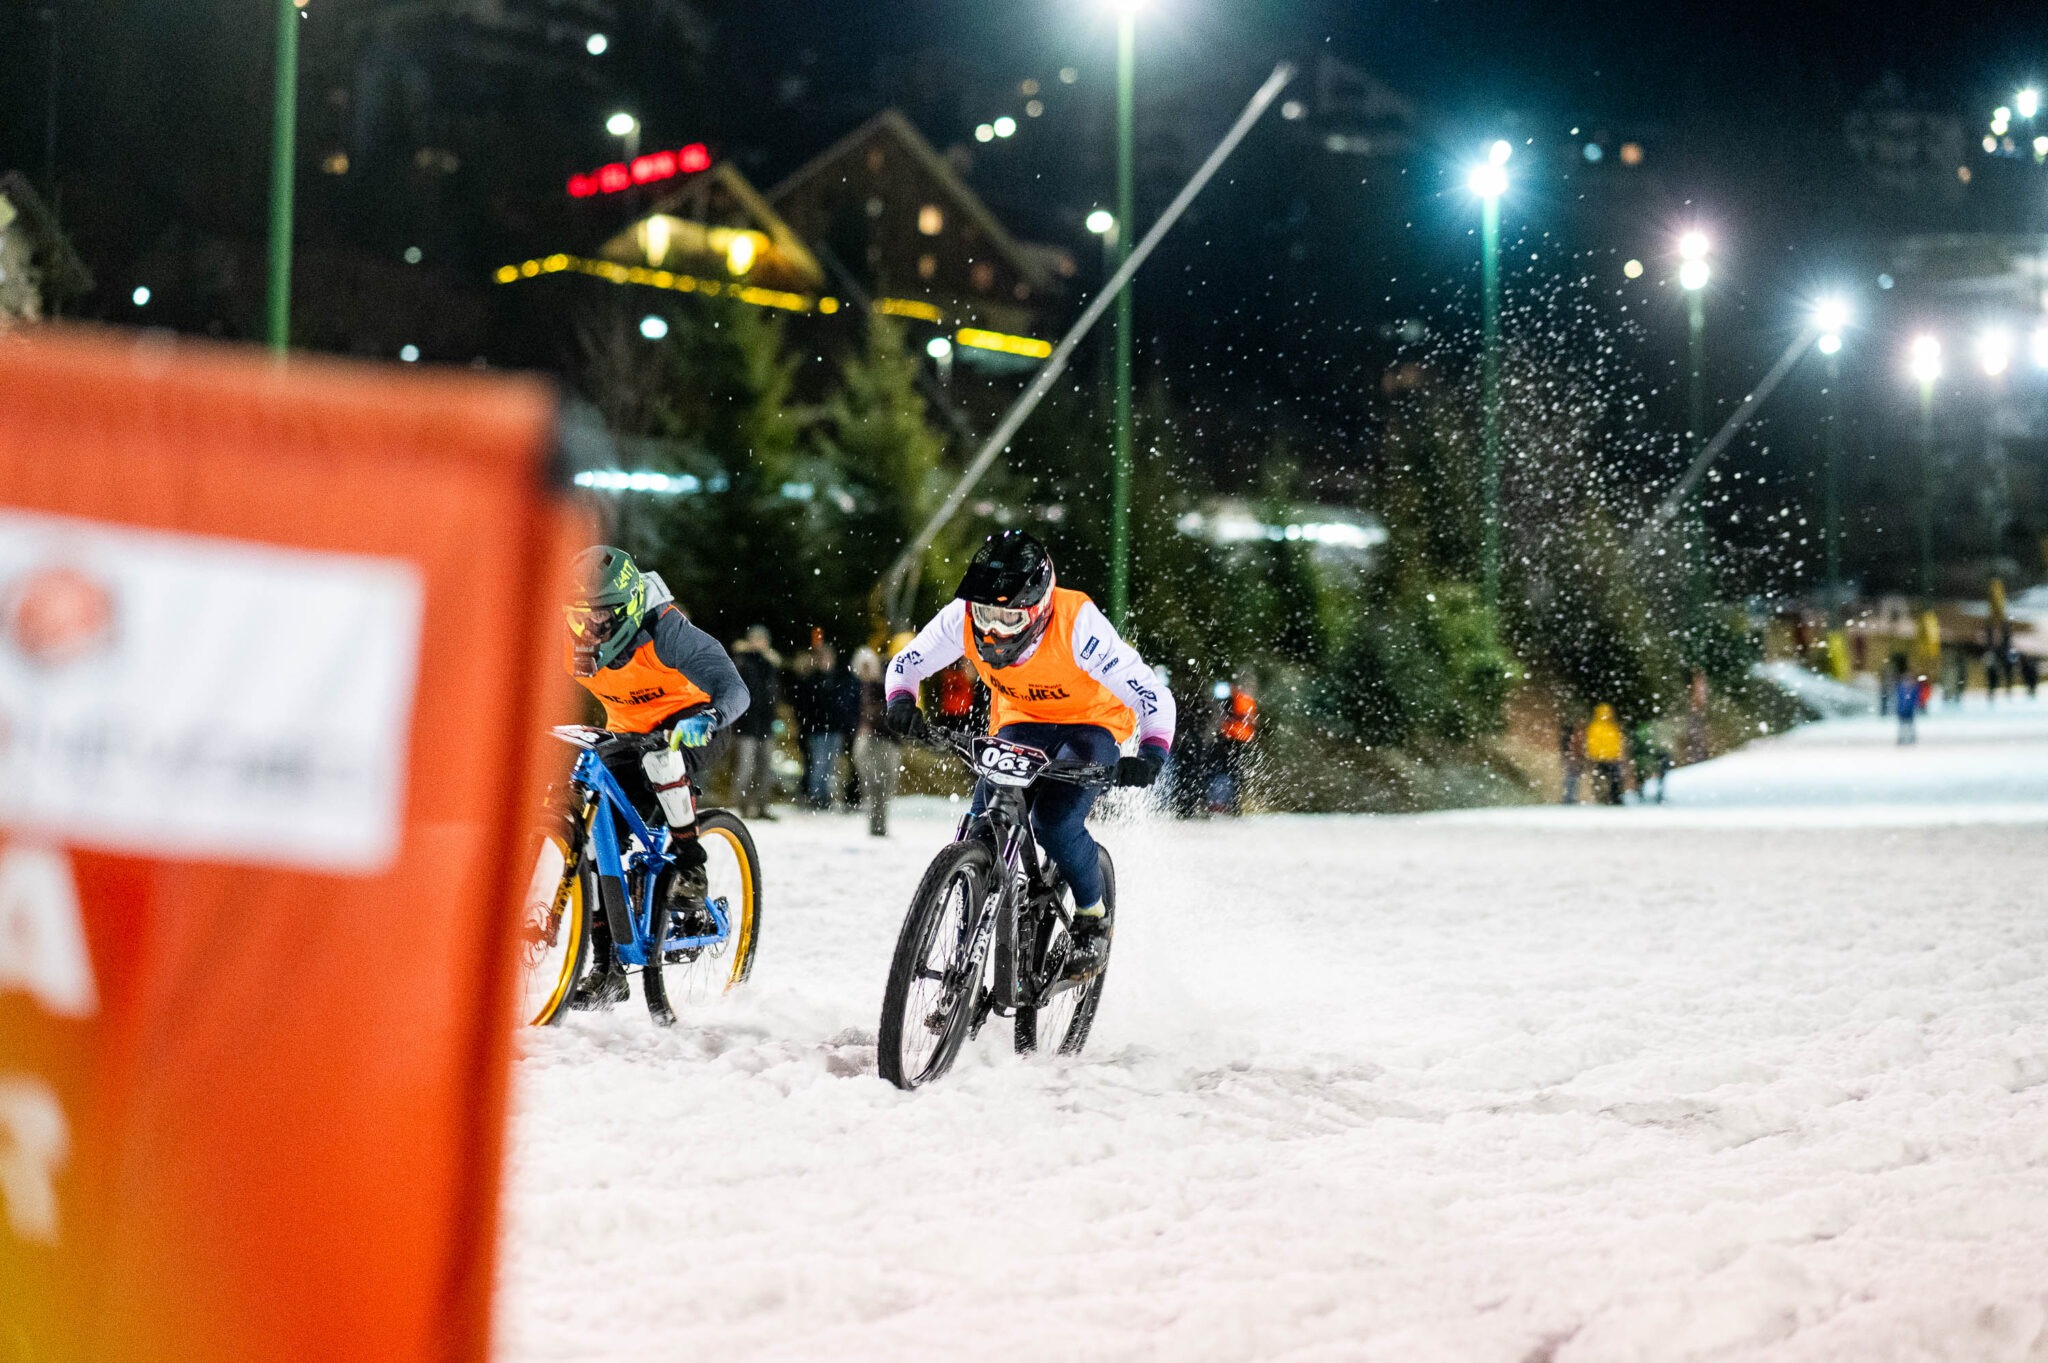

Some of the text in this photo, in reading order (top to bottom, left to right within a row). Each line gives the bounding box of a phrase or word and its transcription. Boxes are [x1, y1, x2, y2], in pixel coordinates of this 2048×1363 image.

[1028, 687, 1070, 701] HELL
[982, 747, 1030, 776] 063
[969, 927, 992, 963] FOX
